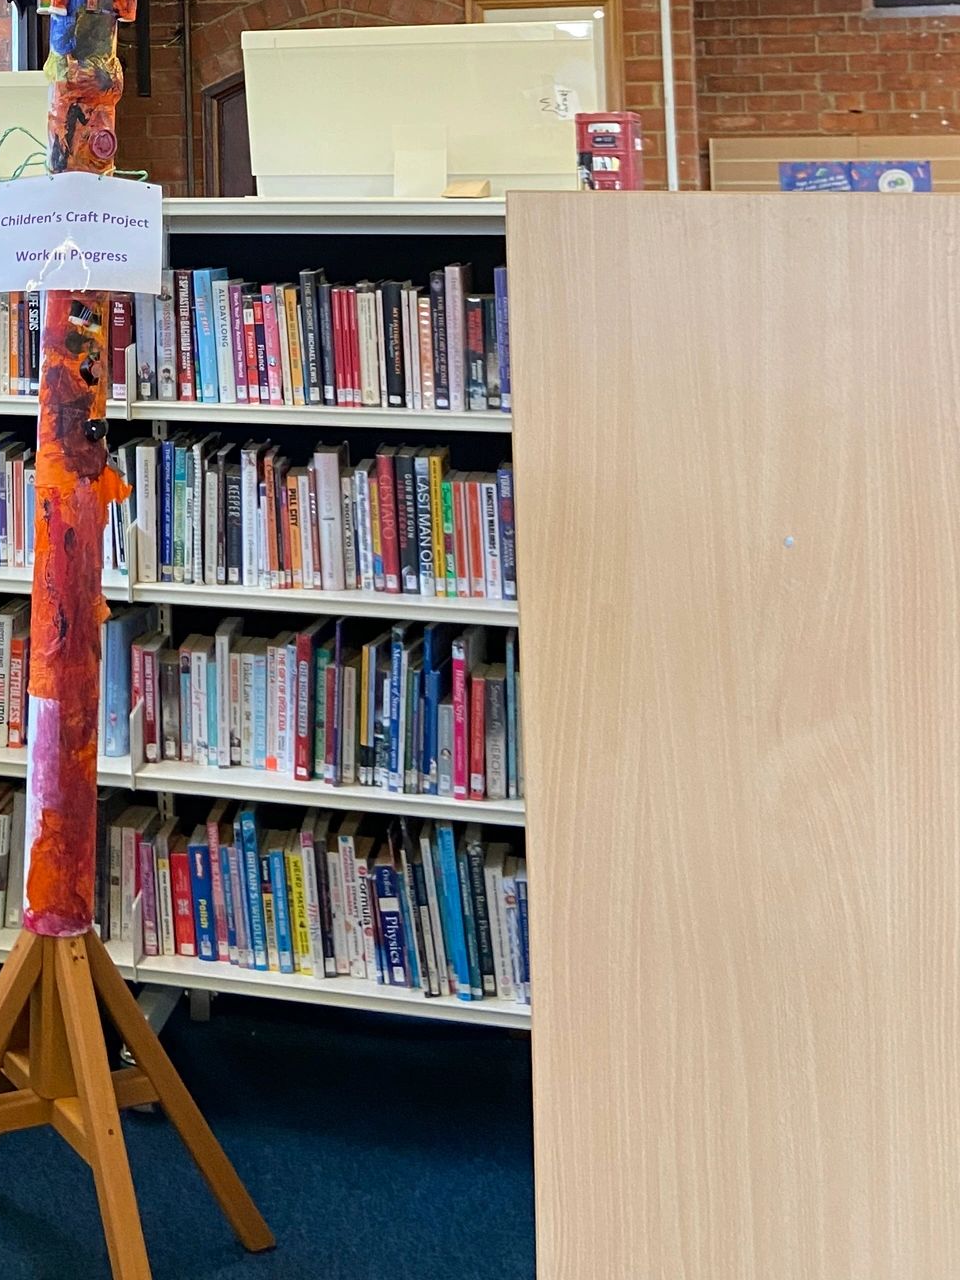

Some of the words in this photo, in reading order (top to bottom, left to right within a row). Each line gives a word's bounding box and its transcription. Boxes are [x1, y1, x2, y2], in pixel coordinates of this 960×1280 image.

[1, 212, 62, 227] Children's
[66, 211, 99, 223] Craft
[102, 212, 149, 228] Project
[16, 249, 50, 262] Work
[54, 249, 66, 261] in
[70, 249, 128, 264] Progress
[28, 292, 38, 307] LIFE
[218, 288, 226, 304] ALL
[304, 282, 312, 296] THE
[28, 309, 39, 331] SIGNS
[219, 305, 227, 322] DAY
[306, 308, 314, 330] SHORT
[220, 323, 228, 348] LONG
[247, 331, 255, 359] Finance
[307, 332, 316, 362] MICHAEL
[257, 344, 266, 371] Finance
[440, 353, 446, 364] OF
[309, 363, 317, 383] LEWIS
[289, 488, 297, 507] PILL
[416, 475, 431, 509] LAST
[500, 474, 511, 498] YOUNG
[228, 484, 240, 517] KEEPER
[380, 475, 395, 540] GESTAPO
[405, 494, 413, 519] BABY
[485, 487, 495, 518] GANGSTER
[166, 514, 171, 522] AT
[290, 508, 298, 527] CITY
[418, 513, 432, 546] MAN
[345, 534, 352, 547] TO
[487, 519, 496, 550] WARLORDS
[420, 549, 433, 577] OFF
[243, 662, 252, 683] Fake
[278, 653, 286, 667] THE
[299, 663, 307, 679] THE
[391, 647, 401, 687] Memories
[278, 668, 286, 684] GIFT
[454, 669, 464, 703] Wedding
[9, 658, 22, 723] FACTFULNESS
[243, 683, 251, 704] Law
[279, 684, 286, 695] OF
[299, 680, 307, 701] HIGH
[145, 692, 154, 721] DARKNESS
[278, 696, 287, 732] DYSLEXIA
[299, 702, 307, 736] STREET
[391, 695, 400, 720] Steam
[456, 703, 464, 723] Style
[292, 859, 302, 889] WEIRD
[381, 869, 392, 897] Oxford
[471, 857, 483, 893] Britain's
[198, 898, 209, 928] Polish
[296, 891, 305, 919] MATHS
[358, 875, 372, 926] Formula
[475, 895, 485, 917] Rare
[384, 916, 400, 964] Physics
[479, 919, 489, 953] Flowers
